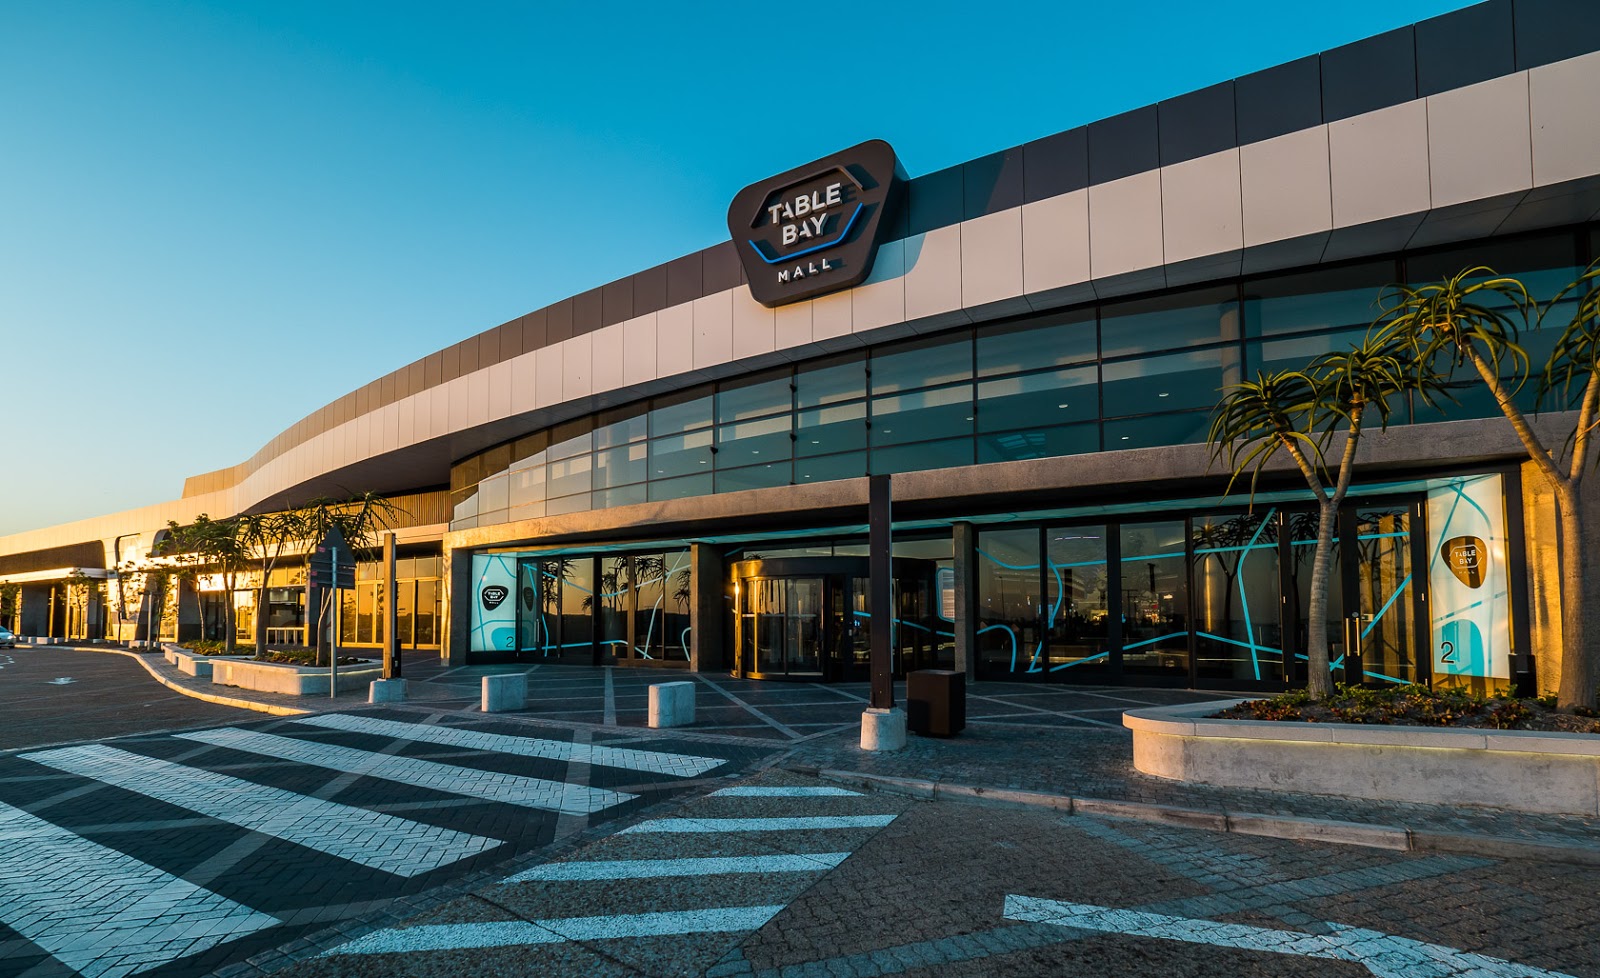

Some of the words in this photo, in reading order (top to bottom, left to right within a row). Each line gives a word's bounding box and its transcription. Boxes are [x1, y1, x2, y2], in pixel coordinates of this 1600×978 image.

[768, 182, 841, 225] TABLE
[782, 213, 827, 246] BAY
[778, 258, 831, 282] MALL
[1455, 549, 1476, 558] TABLE
[506, 636, 514, 648] 2
[1440, 641, 1454, 663] 2
